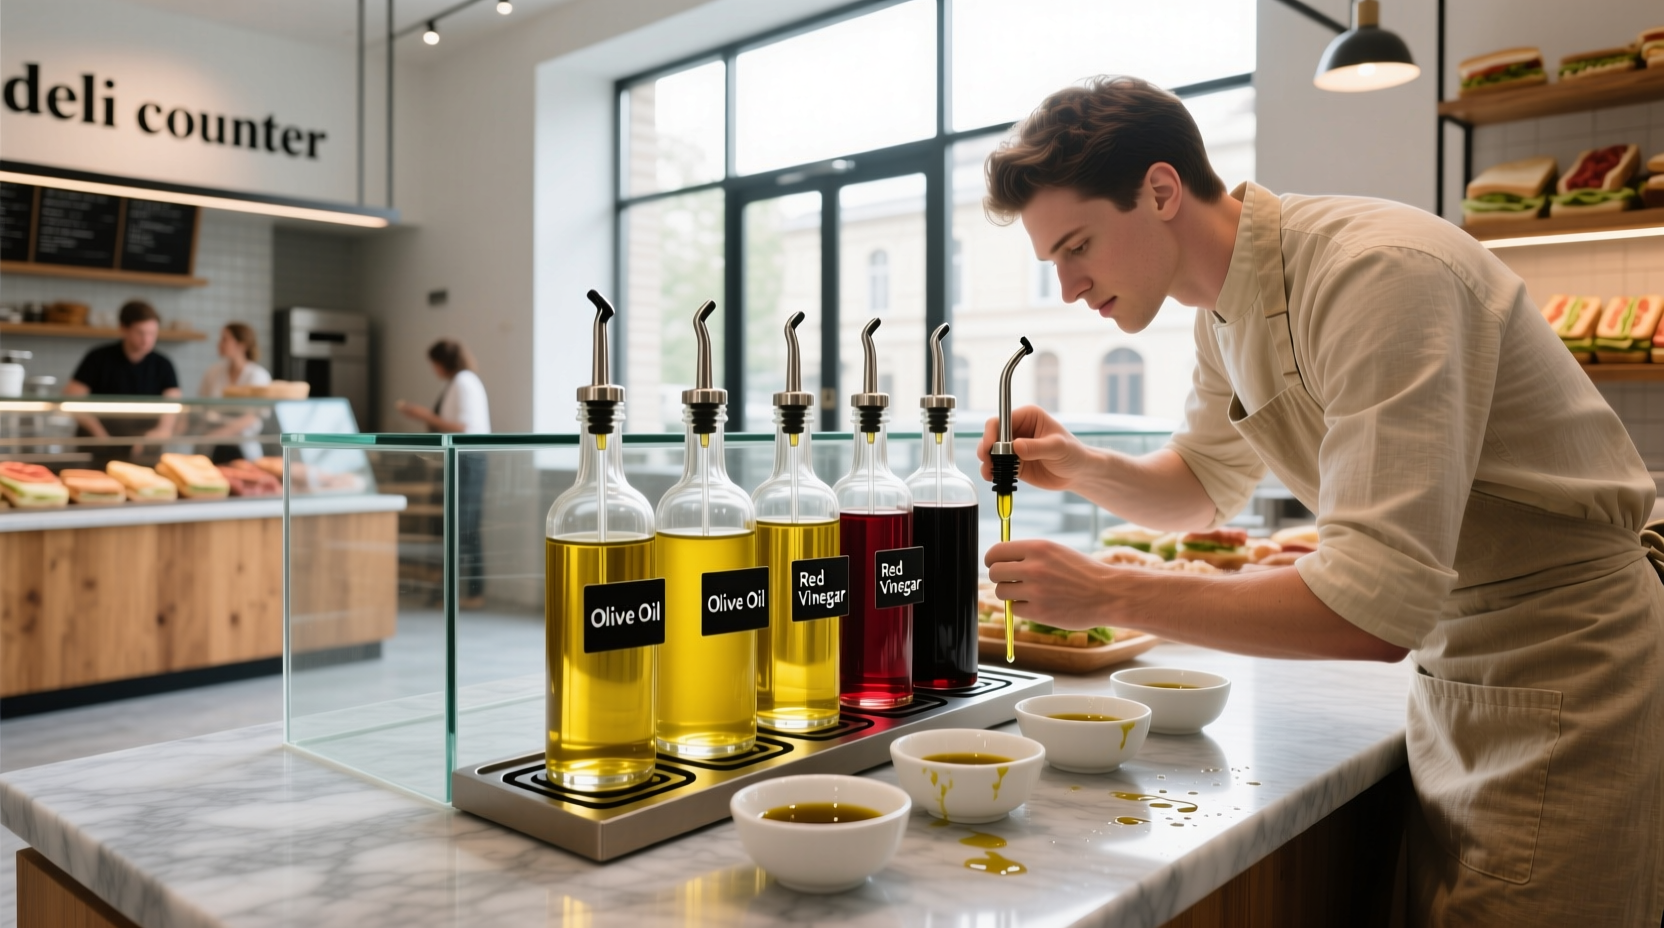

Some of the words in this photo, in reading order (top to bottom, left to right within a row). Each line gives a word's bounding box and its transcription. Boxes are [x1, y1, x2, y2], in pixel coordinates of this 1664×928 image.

[2, 62, 115, 127] deli
[137, 102, 327, 160] counter
[799, 568, 825, 588] Red
[881, 559, 903, 578] Red
[707, 593, 743, 613] Olive
[746, 589, 765, 609] Oil
[590, 606, 635, 628] Olive
[638, 600, 661, 622] Oil
